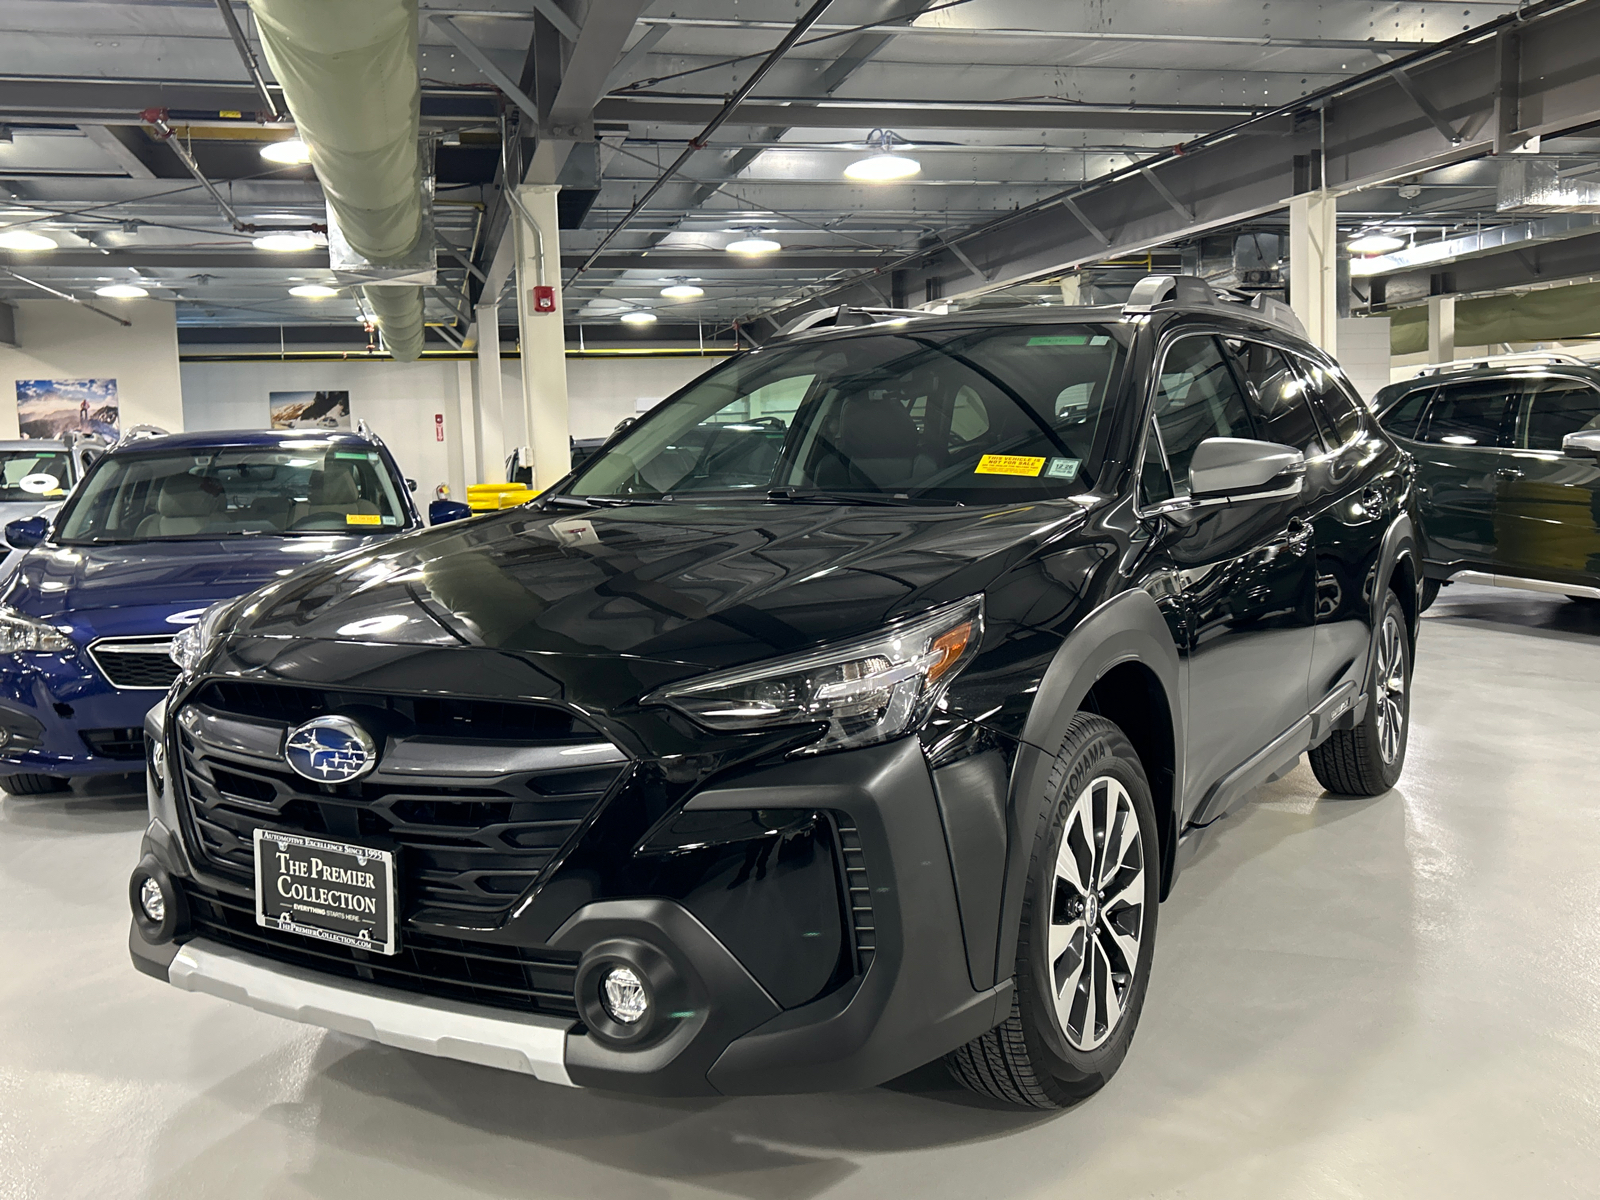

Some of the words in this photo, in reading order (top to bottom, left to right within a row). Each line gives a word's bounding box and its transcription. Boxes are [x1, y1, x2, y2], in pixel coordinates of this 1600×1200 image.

[1053, 740, 1106, 828] YOKOHAMA
[364, 849, 382, 860] 1995
[293, 903, 326, 916] EVERYTHING
[326, 910, 345, 919] STARTS
